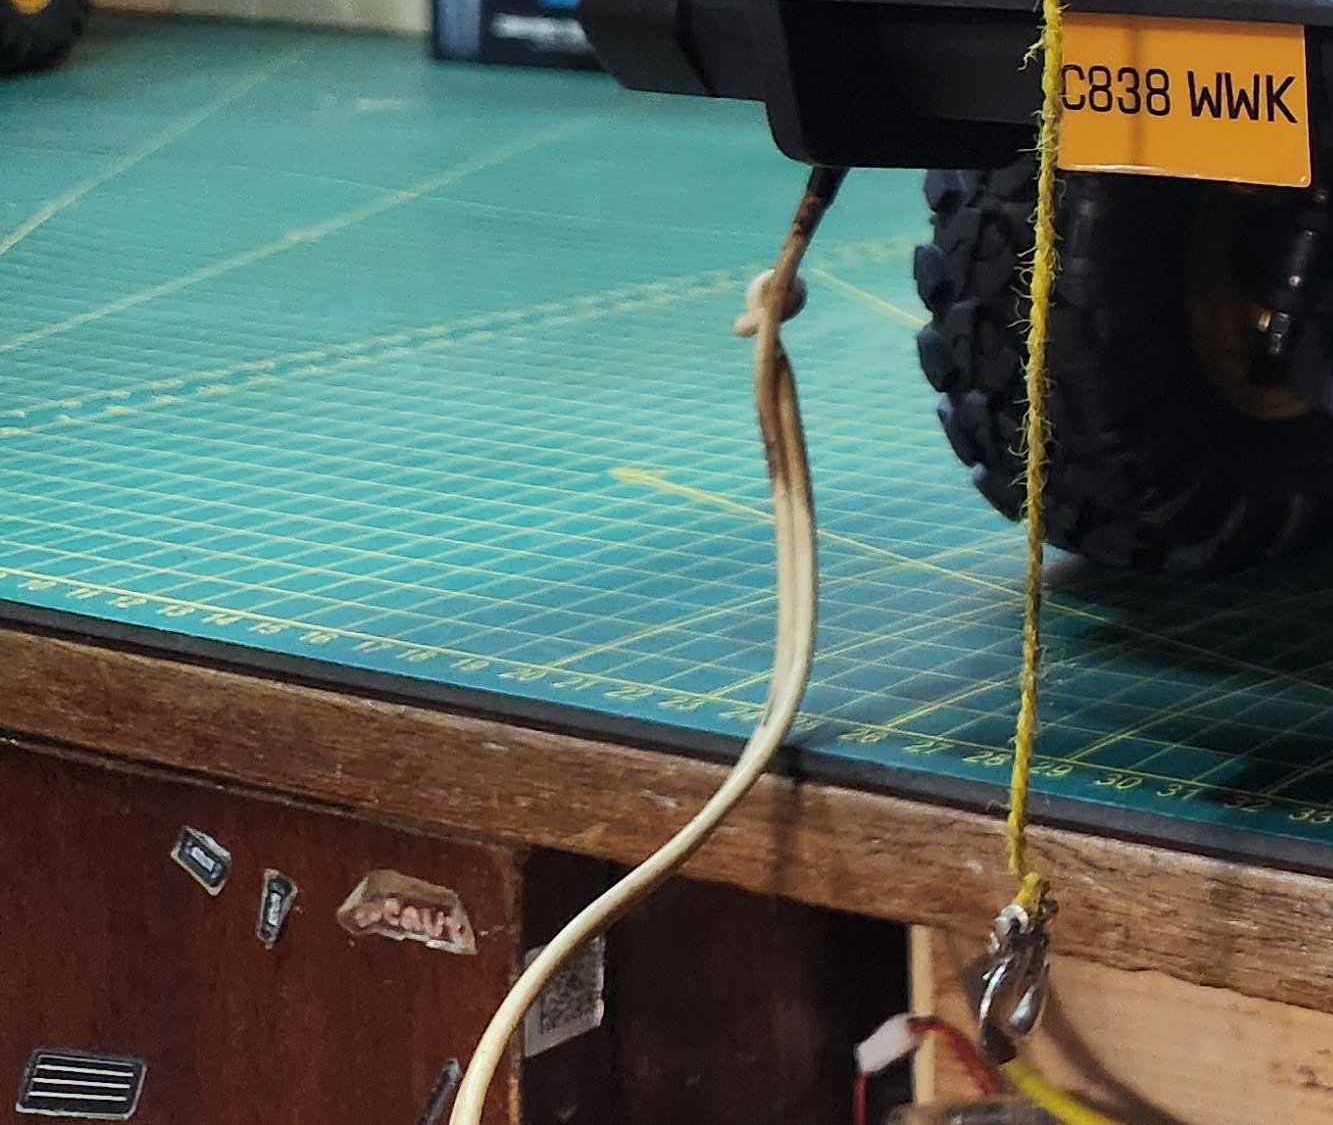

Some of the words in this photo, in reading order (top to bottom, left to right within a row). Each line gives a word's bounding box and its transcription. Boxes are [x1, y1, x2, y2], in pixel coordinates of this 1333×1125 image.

[1061, 64, 1171, 117] C838
[1187, 70, 1298, 124] WWK
[903, 740, 955, 755] 27
[963, 750, 1012, 766] 28
[1030, 761, 1074, 777] 29
[1094, 772, 1143, 790] 30
[1156, 783, 1202, 801] 31
